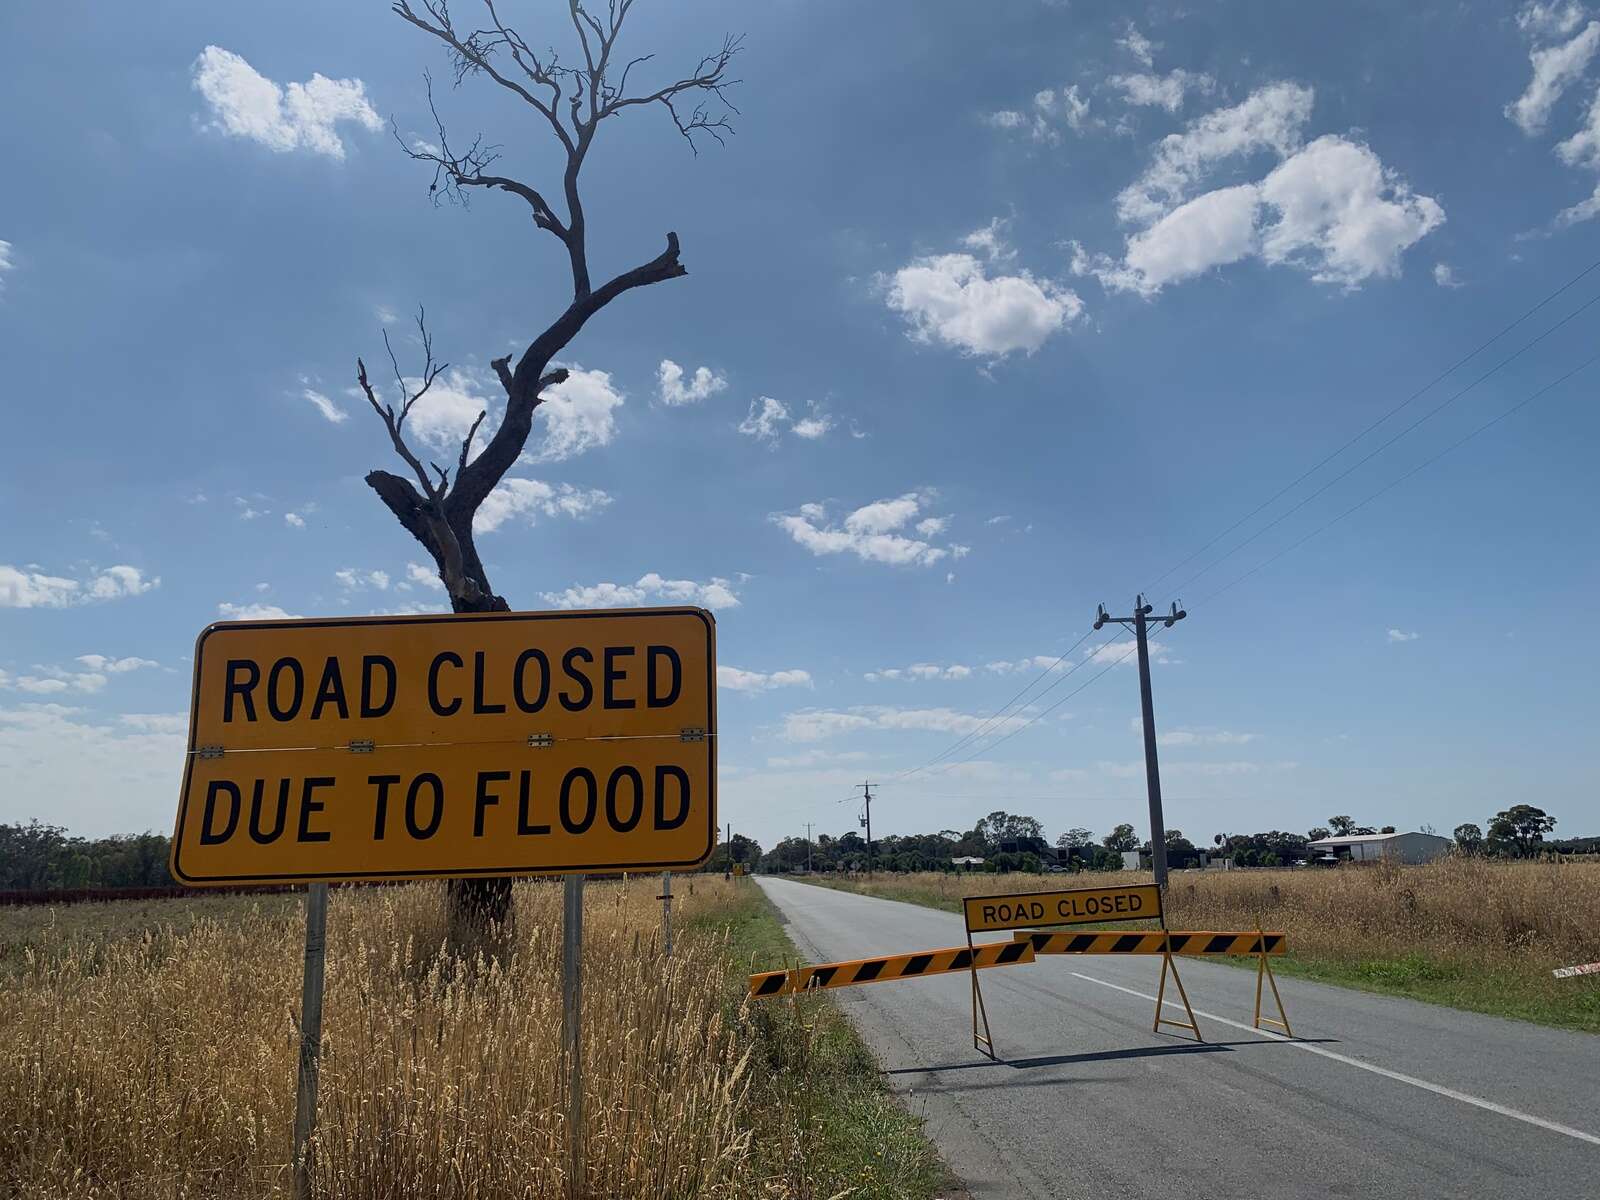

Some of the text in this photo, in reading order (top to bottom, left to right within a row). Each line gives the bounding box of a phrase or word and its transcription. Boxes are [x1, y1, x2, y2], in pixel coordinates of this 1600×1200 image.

[223, 645, 683, 723] ROAD CLOSED
[199, 765, 691, 846] DUE TO FLOOD
[983, 894, 1143, 924] ROAD CLOSED
